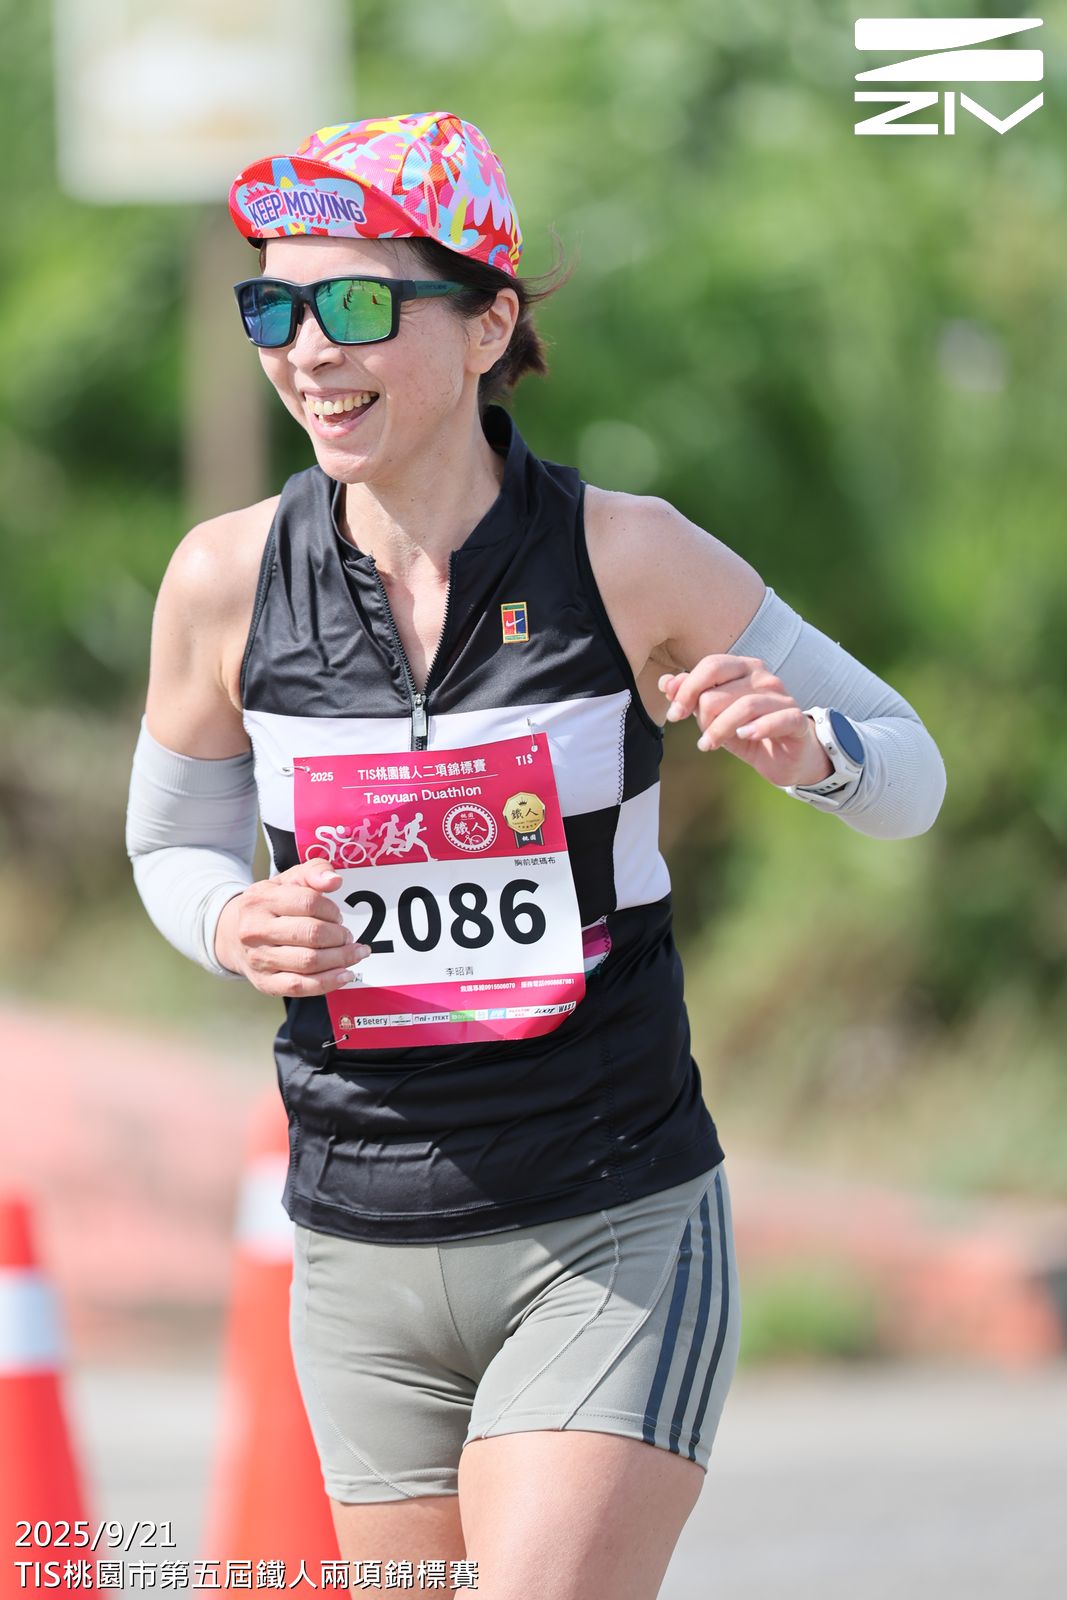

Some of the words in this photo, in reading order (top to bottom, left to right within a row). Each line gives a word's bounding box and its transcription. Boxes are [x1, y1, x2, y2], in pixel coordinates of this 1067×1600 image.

[248, 193, 282, 228] KEEP
[285, 191, 364, 224] MOVING
[357, 758, 487, 781] TIS桃園鐵人二項錦標賽
[515, 753, 534, 766] TIS
[310, 771, 334, 782] 2025
[363, 792, 418, 805] Taoyuan
[421, 785, 482, 801] Duathlon
[343, 878, 547, 954] 2086
[362, 1015, 388, 1026] Betery
